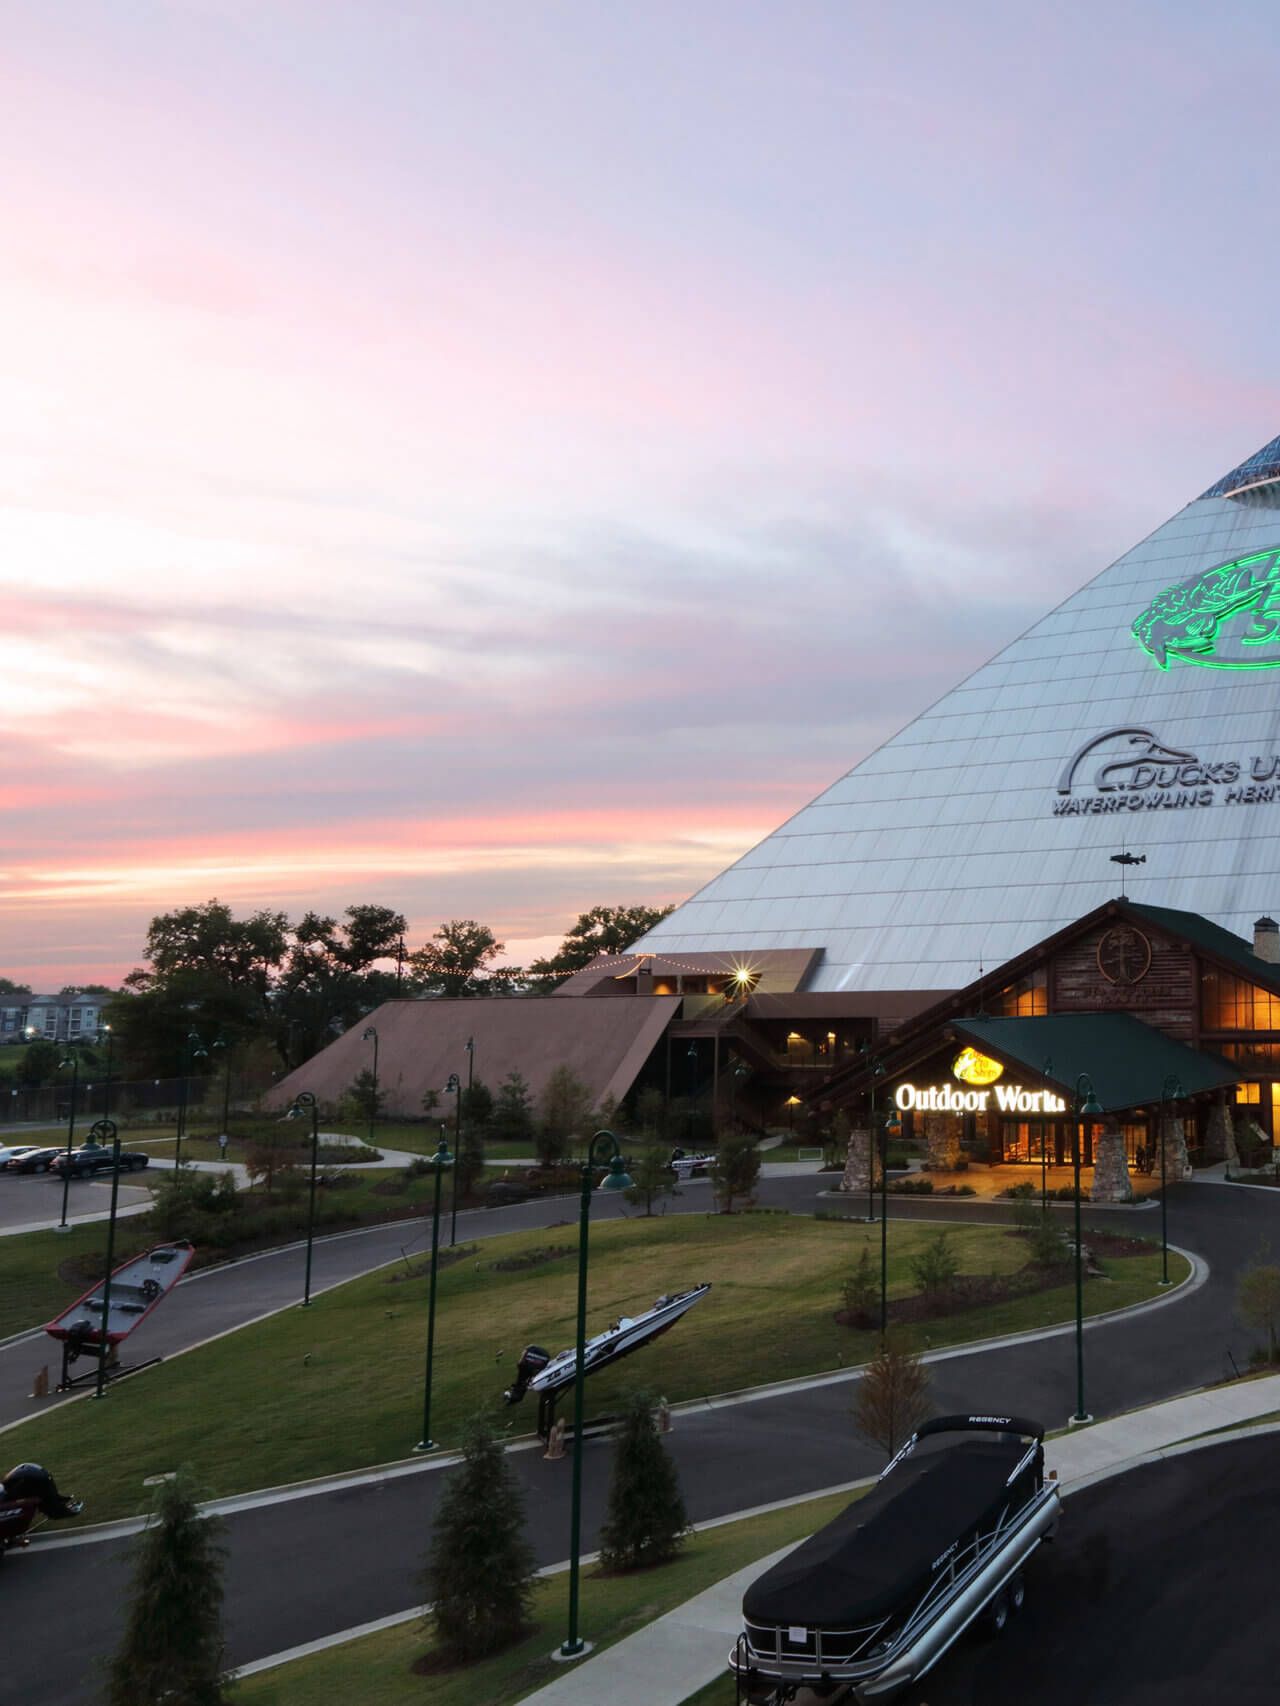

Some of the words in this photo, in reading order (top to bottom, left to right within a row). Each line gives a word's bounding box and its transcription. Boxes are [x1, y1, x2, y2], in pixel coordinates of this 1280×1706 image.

[1127, 761, 1240, 790] DUCKS
[1053, 789, 1214, 816] WATERFOWLING
[896, 1083, 990, 1112] Outdoor
[968, 1416, 1012, 1424] REGENCY
